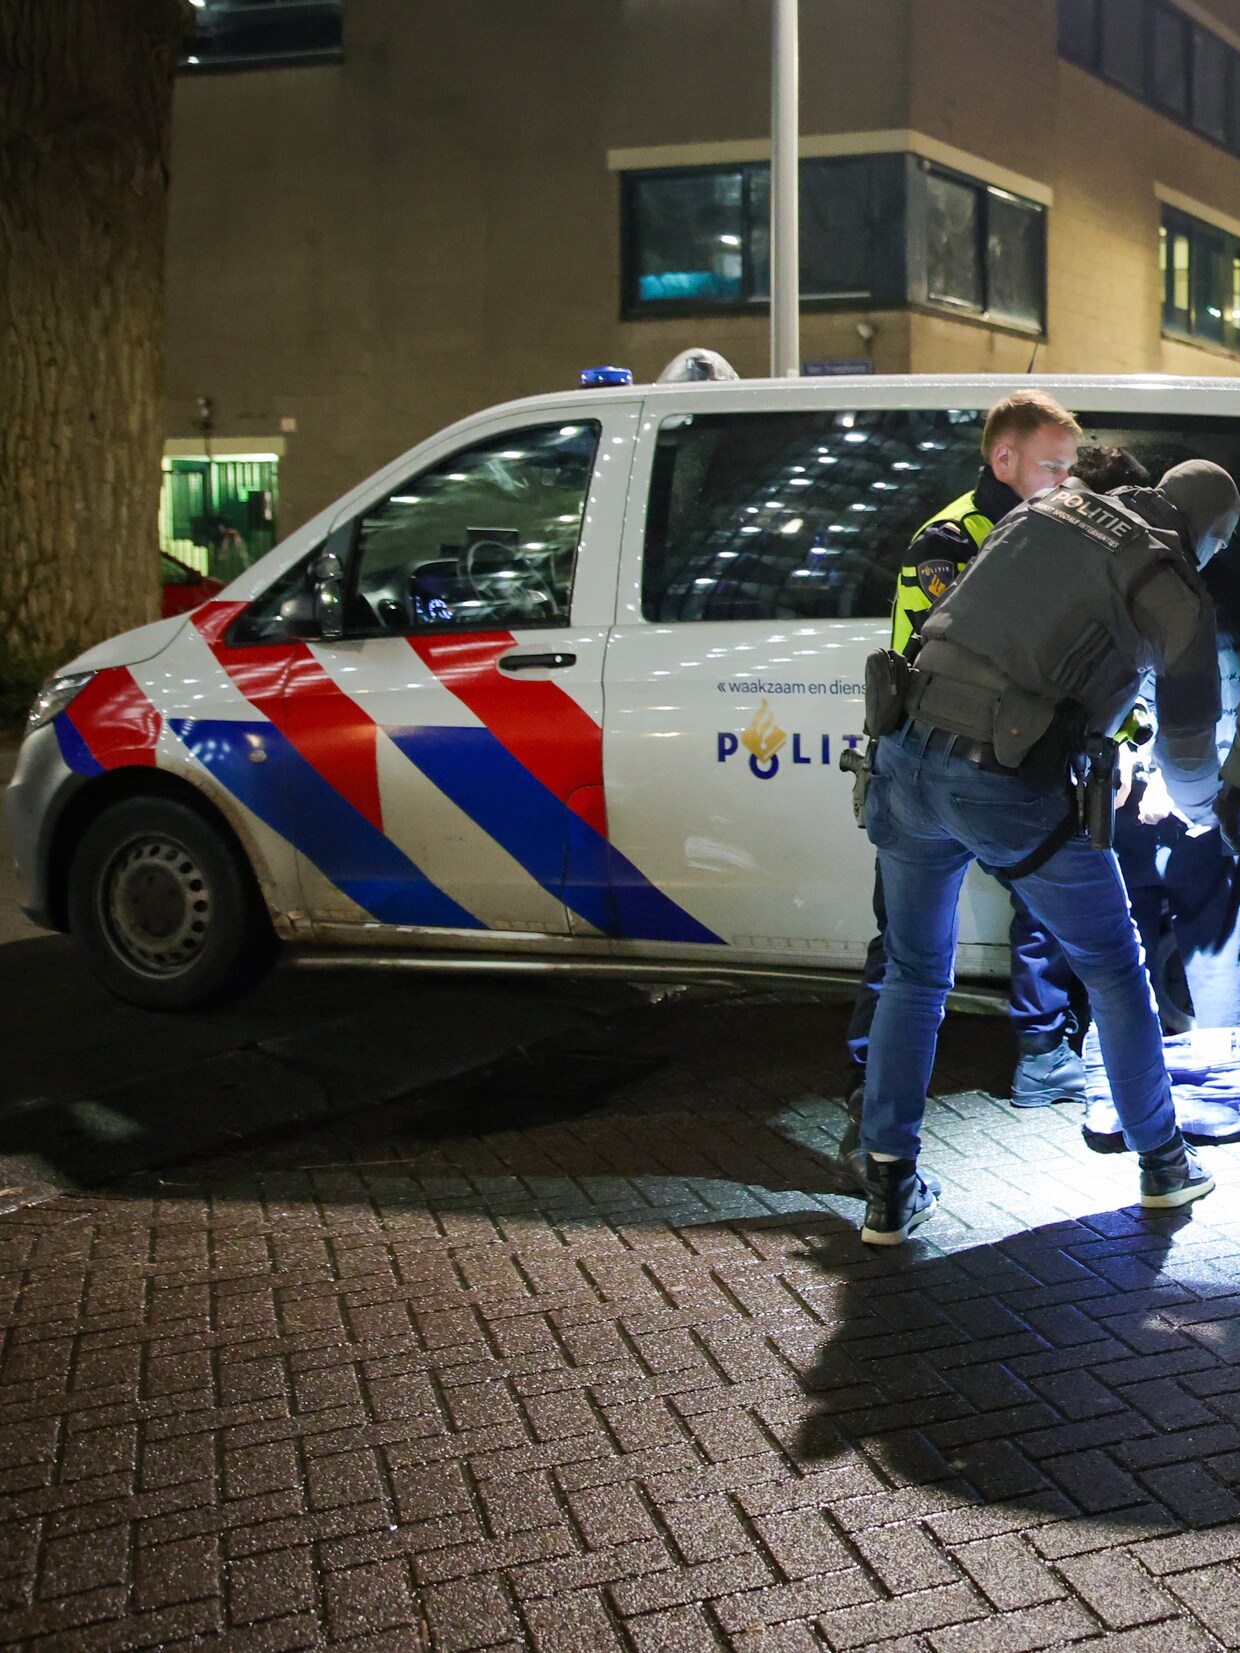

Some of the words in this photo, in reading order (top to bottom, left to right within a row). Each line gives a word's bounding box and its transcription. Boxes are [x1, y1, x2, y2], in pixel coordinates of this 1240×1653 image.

[1051, 490, 1133, 537] POLITIE
[728, 679, 805, 694] waakzaam
[808, 682, 826, 694] en
[829, 680, 867, 695] diens
